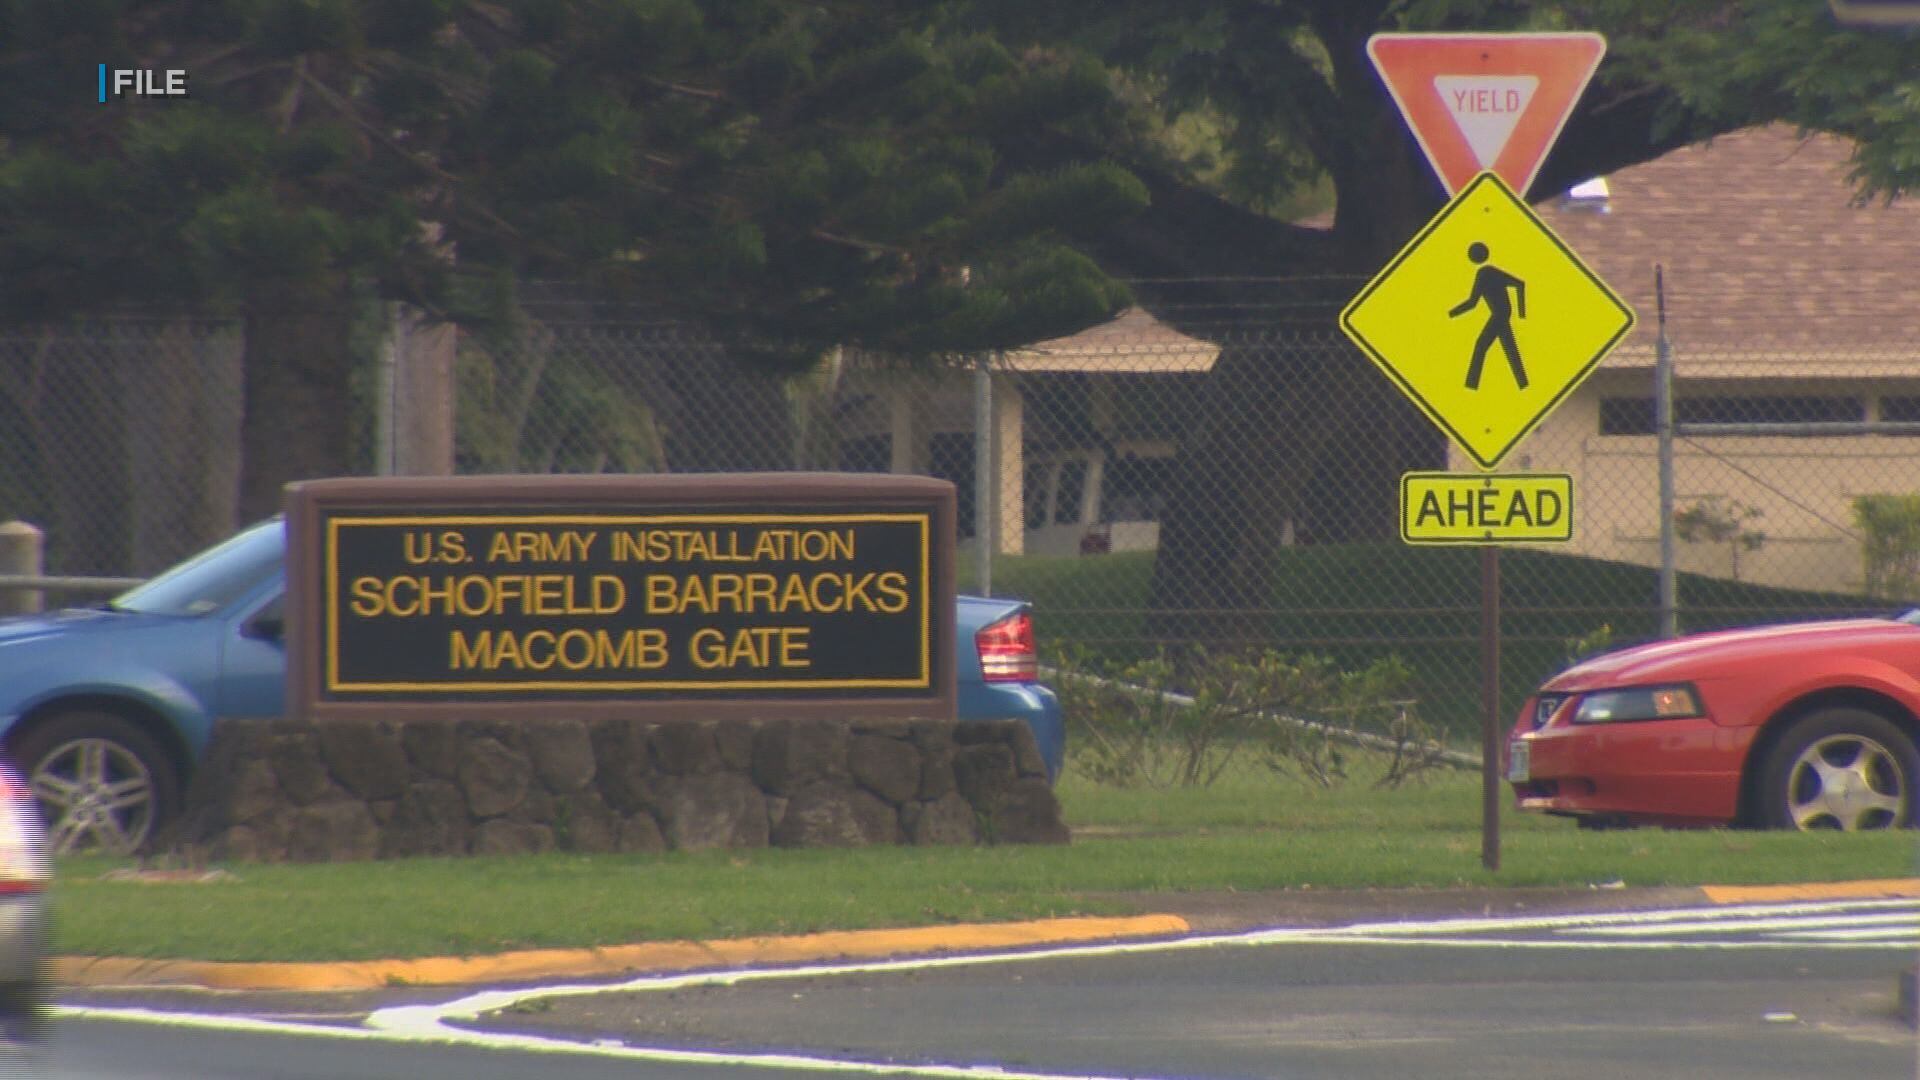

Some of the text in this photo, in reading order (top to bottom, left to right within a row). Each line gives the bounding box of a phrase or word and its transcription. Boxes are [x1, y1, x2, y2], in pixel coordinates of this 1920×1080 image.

[1453, 89, 1520, 112] YIELD
[1414, 488, 1562, 527] AHEAD
[403, 528, 856, 564] U.S. ARMY INSTALLATION
[351, 571, 910, 617] SCHOFIELD BARRACKS
[450, 626, 811, 670] MACOMB GATE
